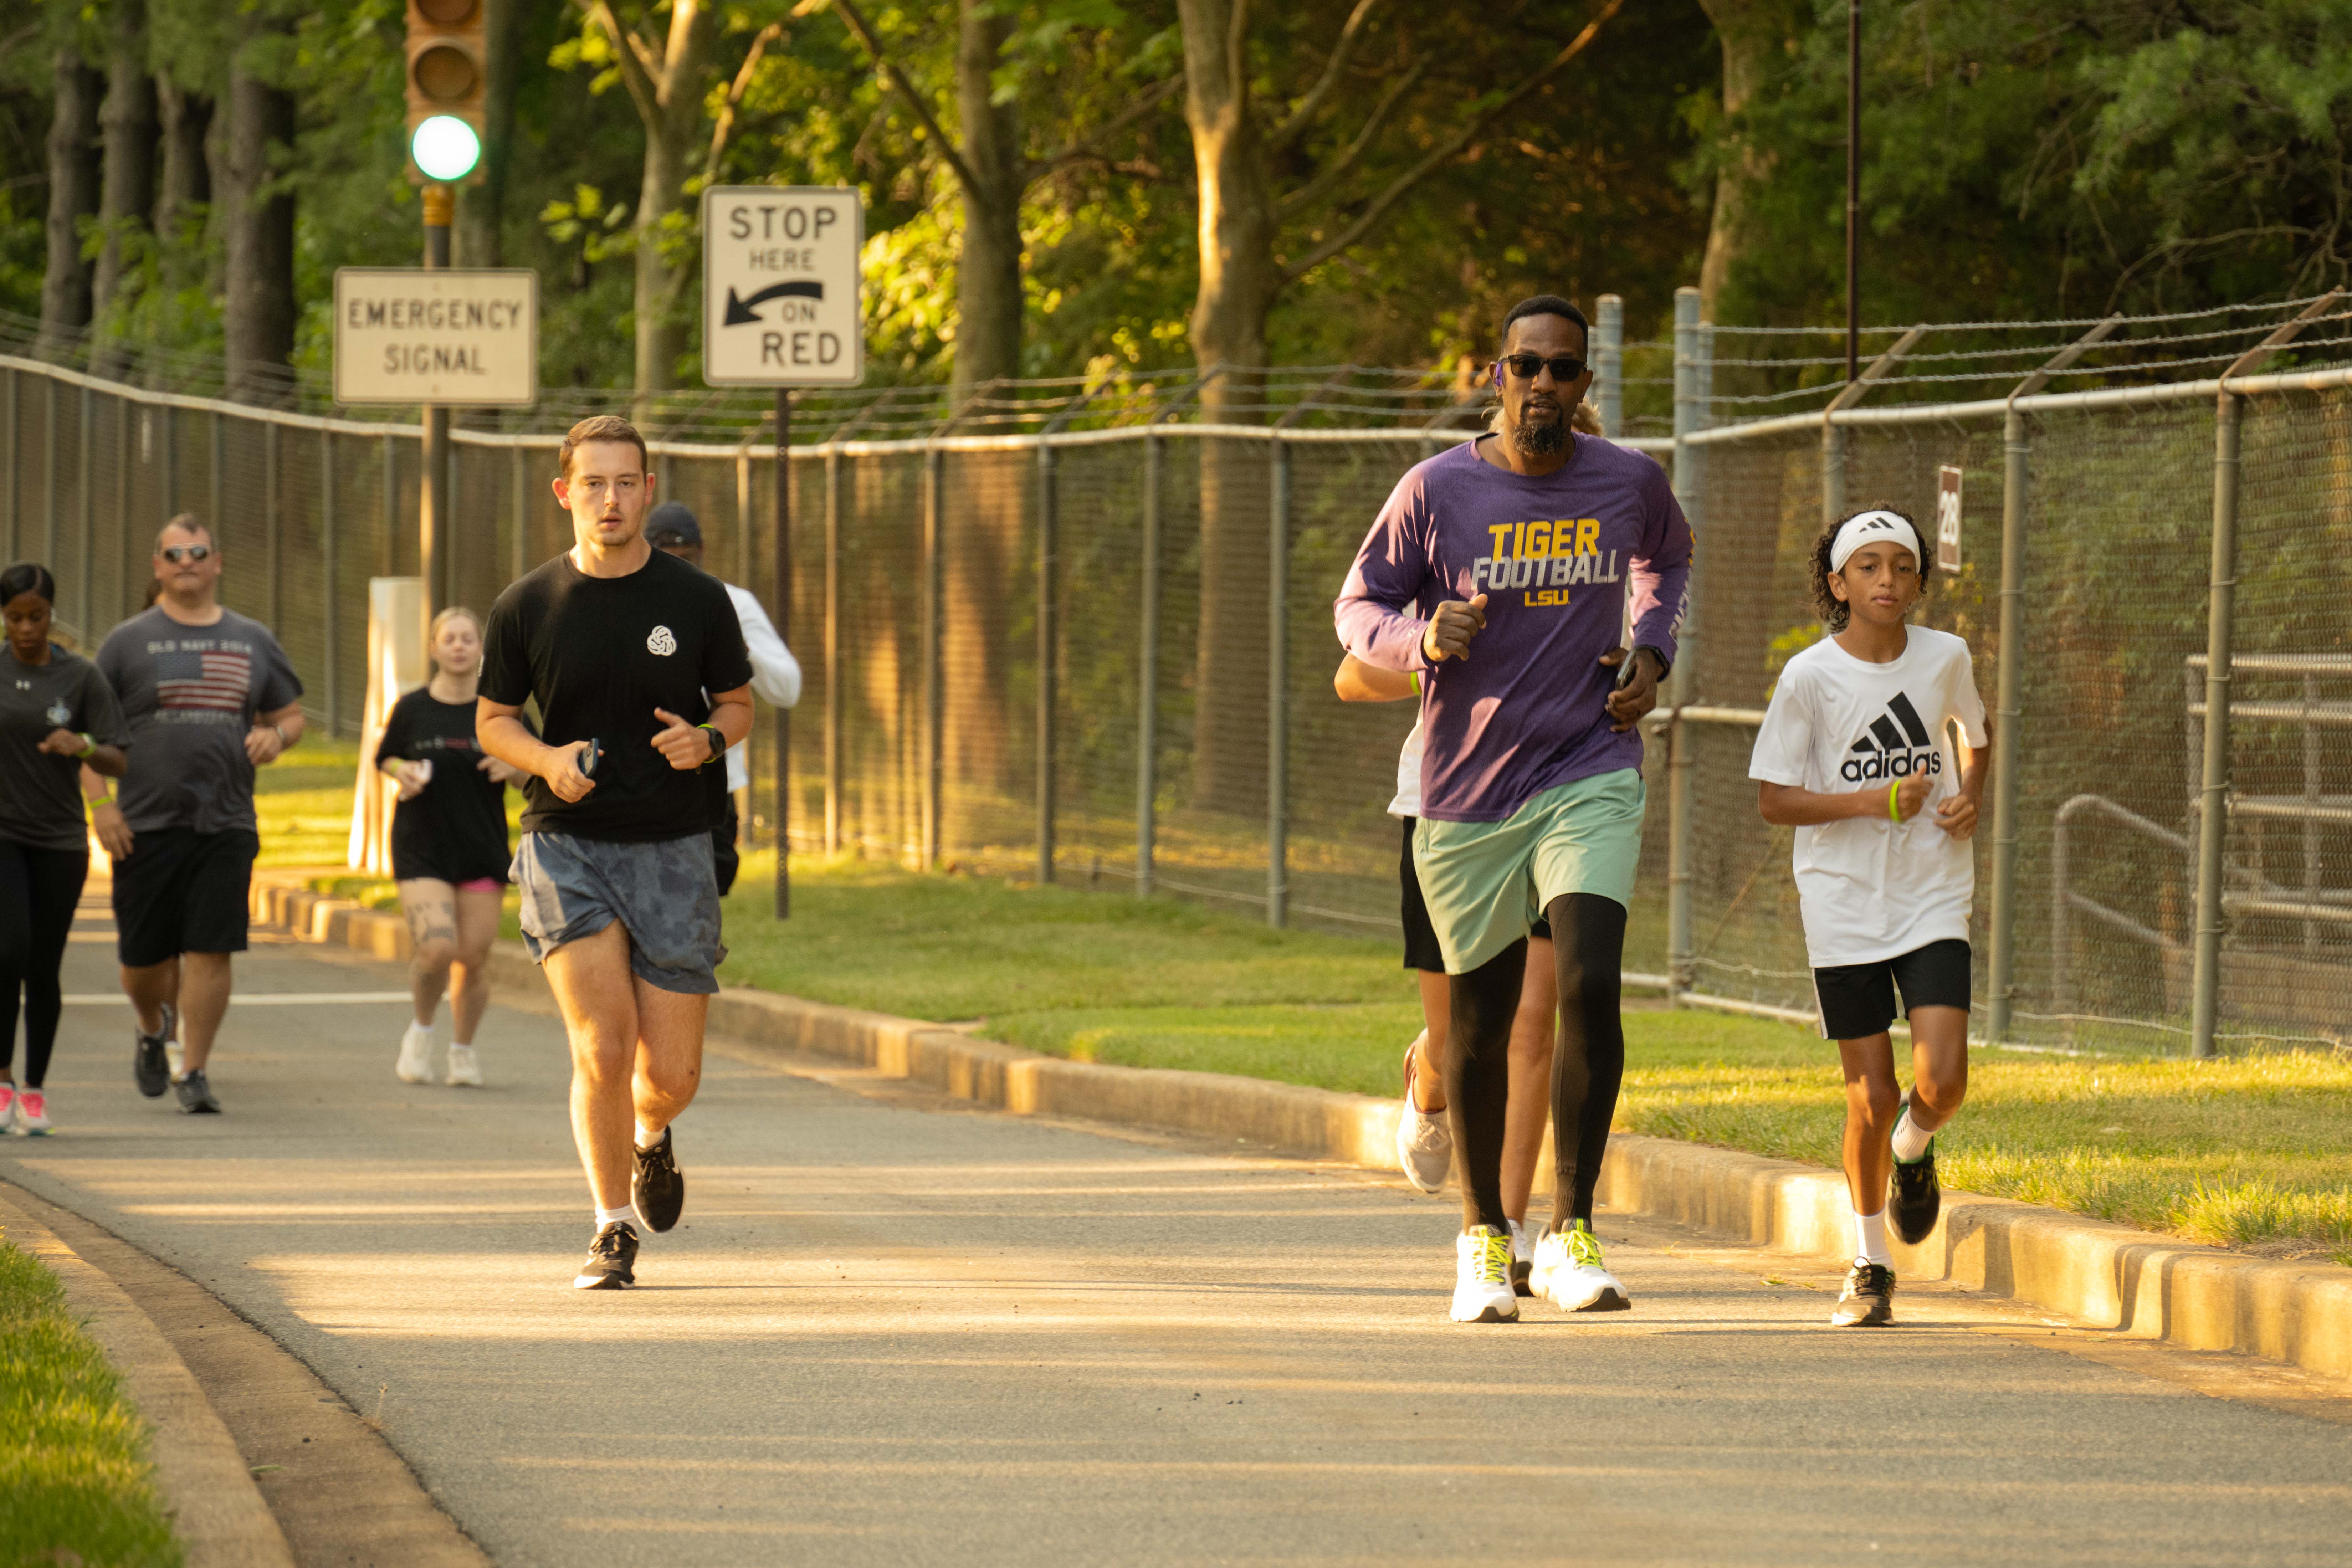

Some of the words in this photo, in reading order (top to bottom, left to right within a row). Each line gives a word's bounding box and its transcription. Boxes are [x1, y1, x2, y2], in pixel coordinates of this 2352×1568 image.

[730, 206, 837, 240] STOP
[749, 248, 814, 271] HERE
[347, 297, 523, 330] EMERGENCY
[782, 301, 816, 323] ON
[383, 342, 487, 376] SIGNAL
[761, 330, 841, 367] RED
[1940, 490, 1958, 546] 28
[1488, 518, 1600, 562] TIGER
[1470, 549, 1619, 591] FOOTBALL
[1524, 589, 1569, 607] LSU
[1840, 747, 1941, 782] adidas
